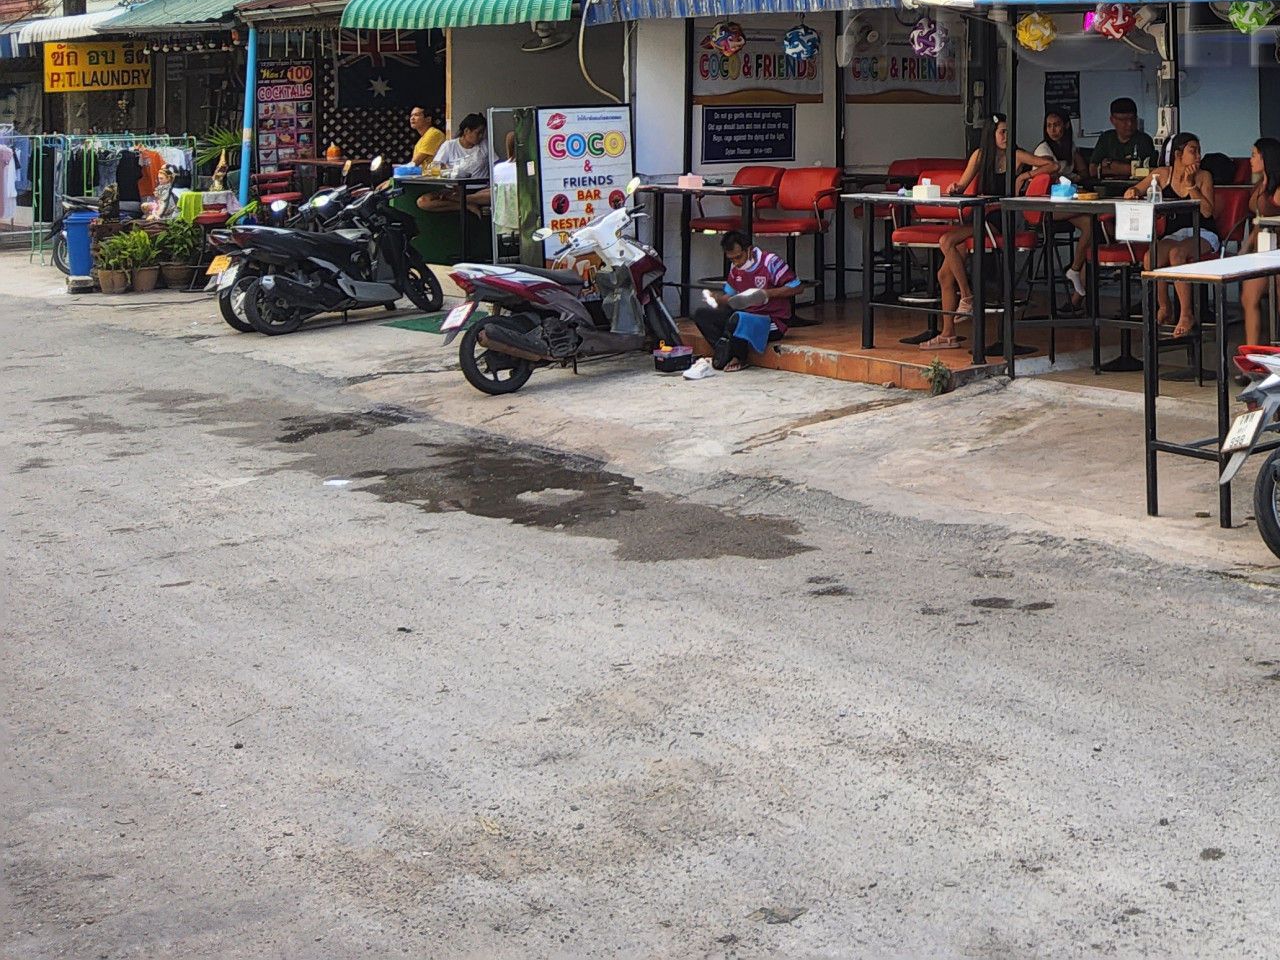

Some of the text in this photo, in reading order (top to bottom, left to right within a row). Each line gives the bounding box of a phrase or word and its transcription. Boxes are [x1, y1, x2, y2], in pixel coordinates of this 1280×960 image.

[288, 66, 313, 79] 100
[742, 54, 752, 77] &
[755, 54, 818, 81] FRIENDS
[890, 56, 899, 78] &
[901, 56, 956, 81] FRIENDS
[258, 83, 312, 100] COCKTAILS
[548, 132, 626, 158] COCO
[583, 159, 592, 173] &
[563, 175, 613, 188] FRIENDS
[577, 190, 601, 201] BAR
[585, 203, 594, 214] &
